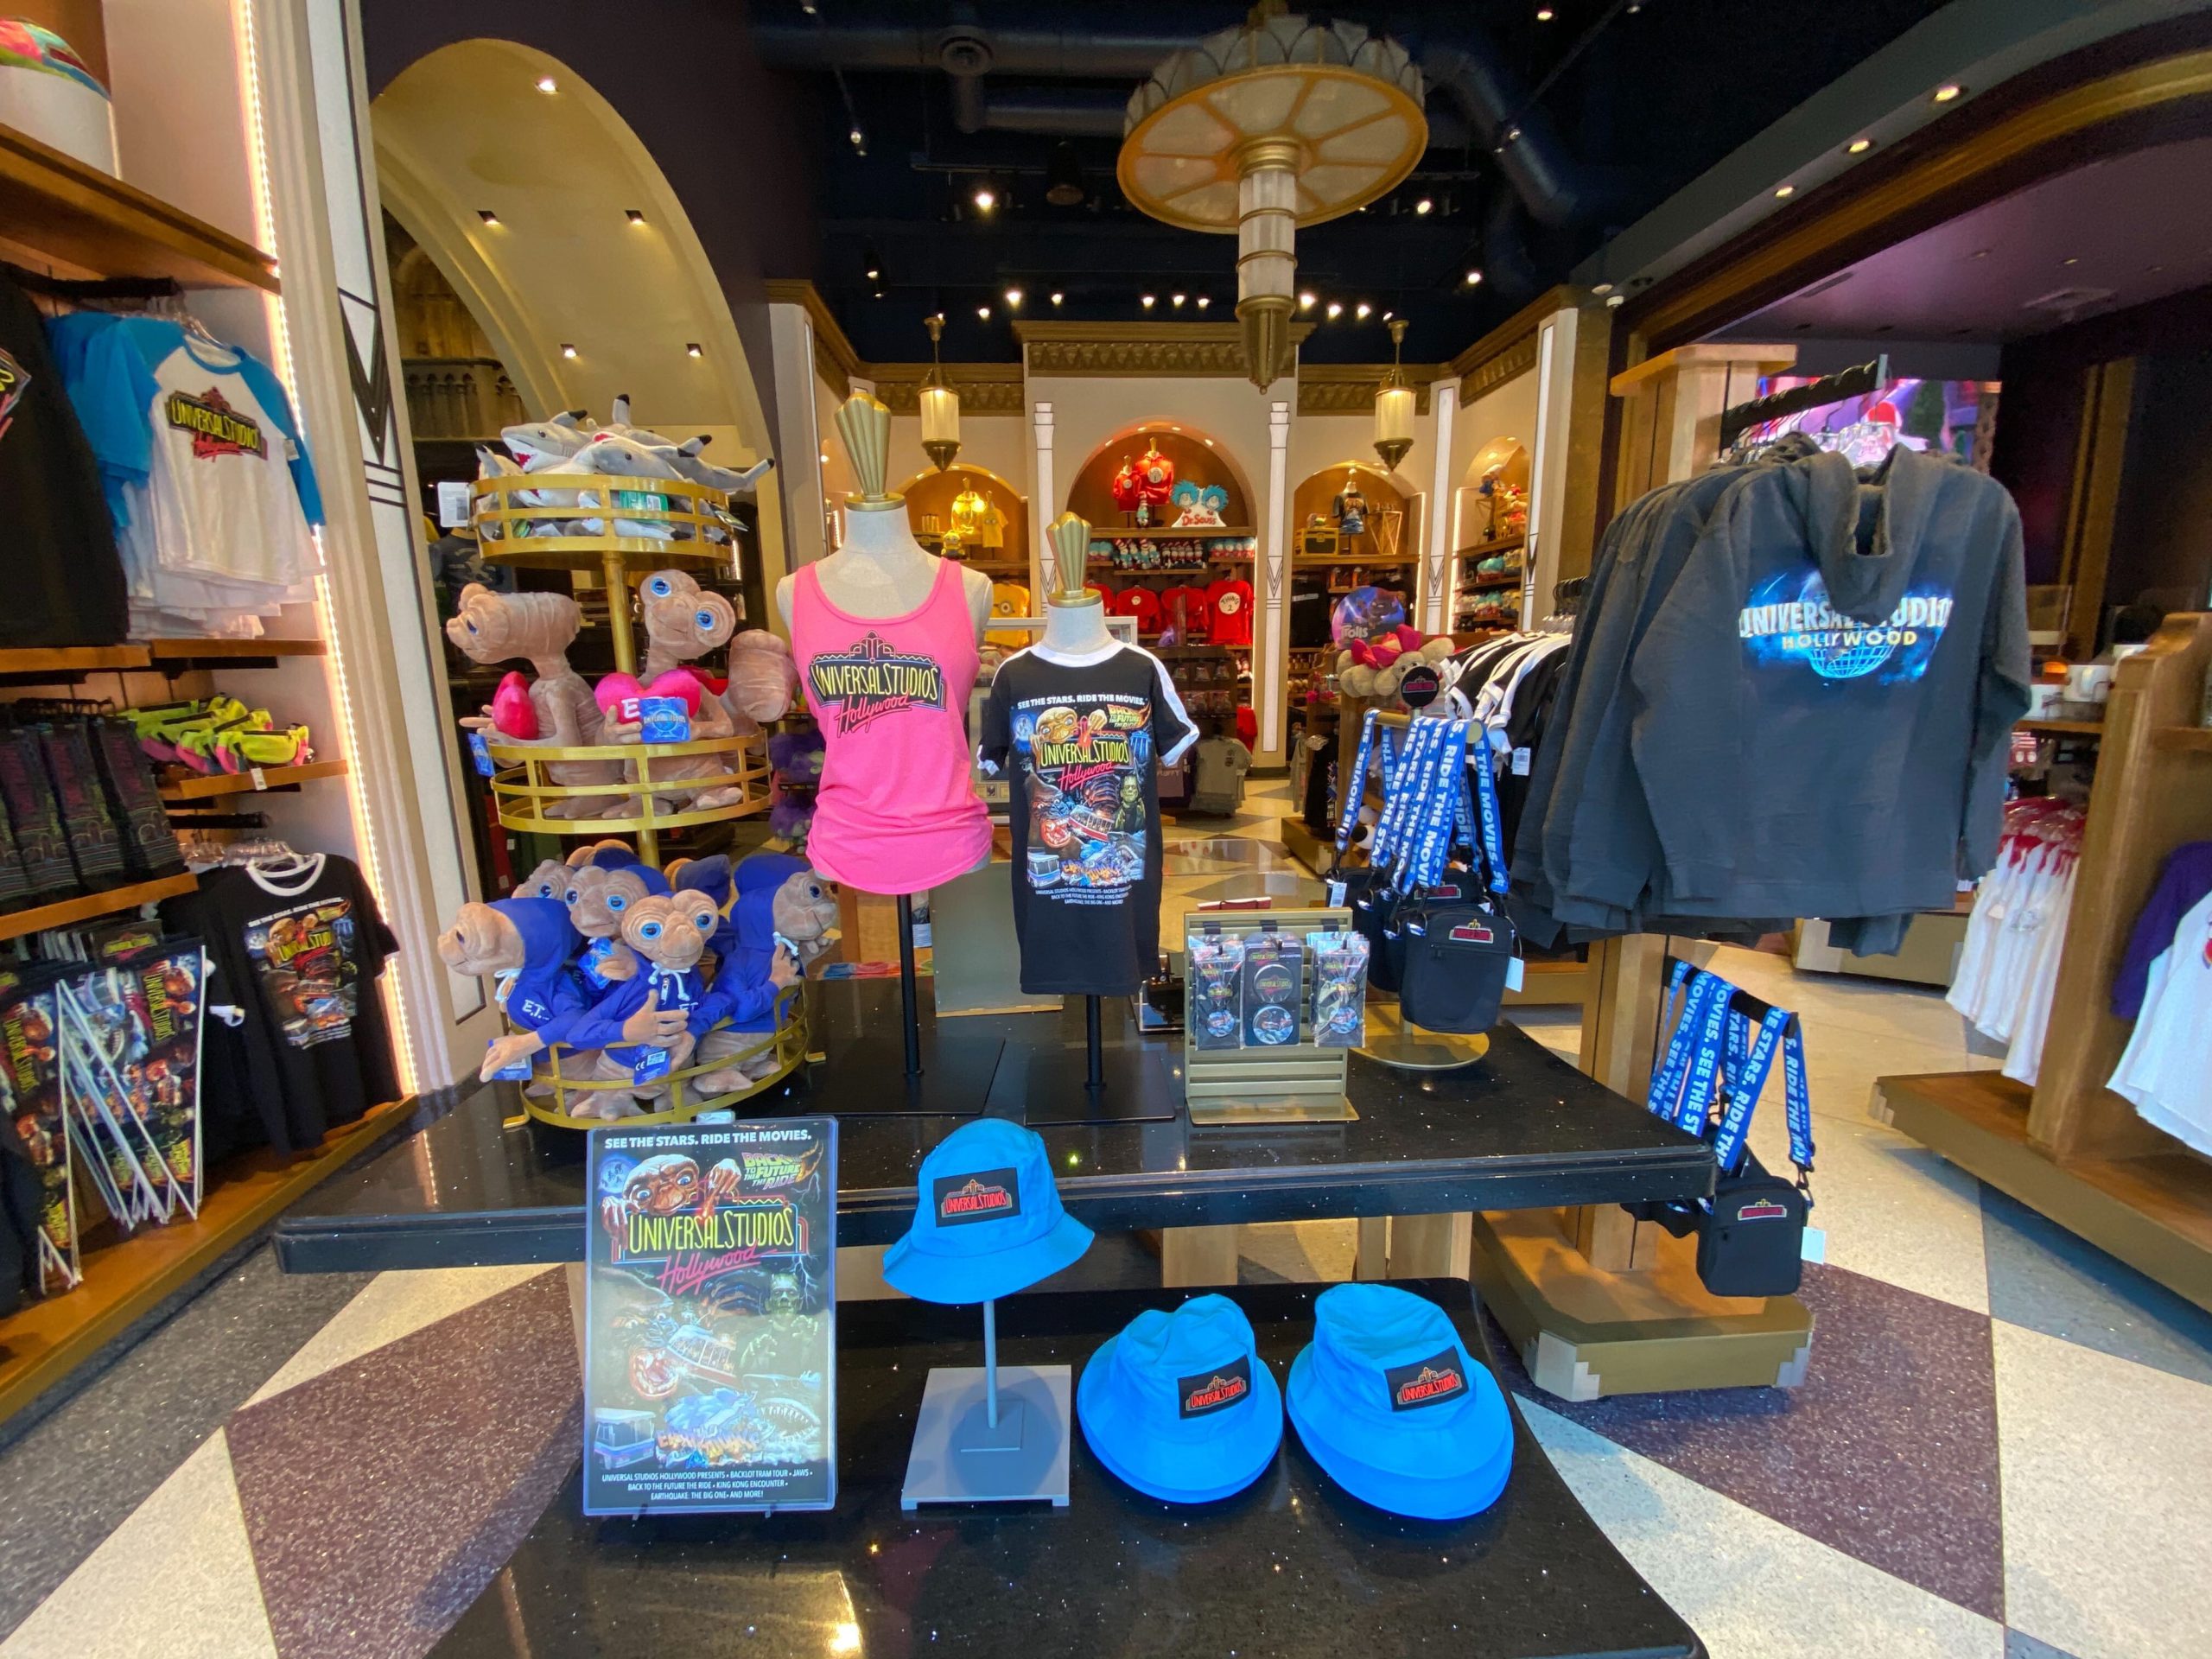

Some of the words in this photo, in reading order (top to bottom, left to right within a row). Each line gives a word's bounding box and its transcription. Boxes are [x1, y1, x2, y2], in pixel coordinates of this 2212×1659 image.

[1194, 514, 1217, 525] Seuss
[1220, 594, 1239, 605] THING
[1341, 625, 1369, 639] Trolls
[1782, 630, 1918, 650] HOLLYWOOD
[883, 663, 938, 701] STUDIOS
[835, 689, 924, 738] Hollywood
[1046, 696, 1076, 704] STARS.
[1115, 694, 1145, 705] MOVIES.
[1040, 741, 1094, 766] UNIVERSAL
[1093, 740, 1129, 764] STUDIOS
[1405, 729, 1427, 787] STARS.
[1438, 745, 1459, 789] RIDE
[1058, 761, 1115, 791] Hollywood
[1392, 762, 1408, 791] SEE
[1416, 760, 1433, 802] RIDE
[1476, 753, 1491, 788] THE
[1382, 793, 1398, 825] THE
[1394, 792, 1410, 831] RIDE
[1407, 804, 1421, 836] THE
[1429, 791, 1448, 827] THE
[1480, 792, 1499, 865] MOVIES.
[1678, 972, 1713, 1035] MOVIES.
[1665, 1039, 1682, 1068] SEE
[1695, 1046, 1715, 1078] SEE
[1742, 1029, 1772, 1084] STARS.
[1653, 1070, 1672, 1101] THE
[1785, 1055, 1799, 1097] RIDE
[1687, 1080, 1707, 1113] THE
[1725, 1090, 1751, 1134] RIDE
[1788, 1098, 1802, 1133] THE
[605, 1137, 628, 1148] SEE
[629, 1136, 653, 1147] THE
[655, 1135, 698, 1147] STARS.
[701, 1134, 731, 1145] RIDE
[732, 1132, 757, 1144] THE
[759, 1129, 812, 1142] MOVIES.
[756, 1165, 802, 1179] FUTURE
[763, 1174, 798, 1190] RIDE
[629, 1213, 725, 1253] UNIVERSAL
[724, 1207, 794, 1249] STUDIOS
[657, 1239, 777, 1295] Hollywood
[1191, 1390, 1223, 1408] UNIVERSAL
[1220, 1378, 1244, 1400] STUDIOS
[1402, 1383, 1436, 1402] UNIVERSAL
[1434, 1374, 1459, 1394] STUDIOS
[602, 1473, 633, 1482] UNIVERSAL
[634, 1472, 659, 1481] STUDIOS
[659, 1471, 696, 1480] HOLLYWOOD
[697, 1471, 726, 1479] PRESENTS
[730, 1470, 757, 1478] BACKLOT
[757, 1470, 772, 1478] TRAM
[772, 1469, 788, 1478] TOUR
[792, 1468, 810, 1477] JAWS
[627, 1483, 644, 1491] BACK
[664, 1481, 686, 1490] FUTURE
[743, 1490, 764, 1498] MORE!
